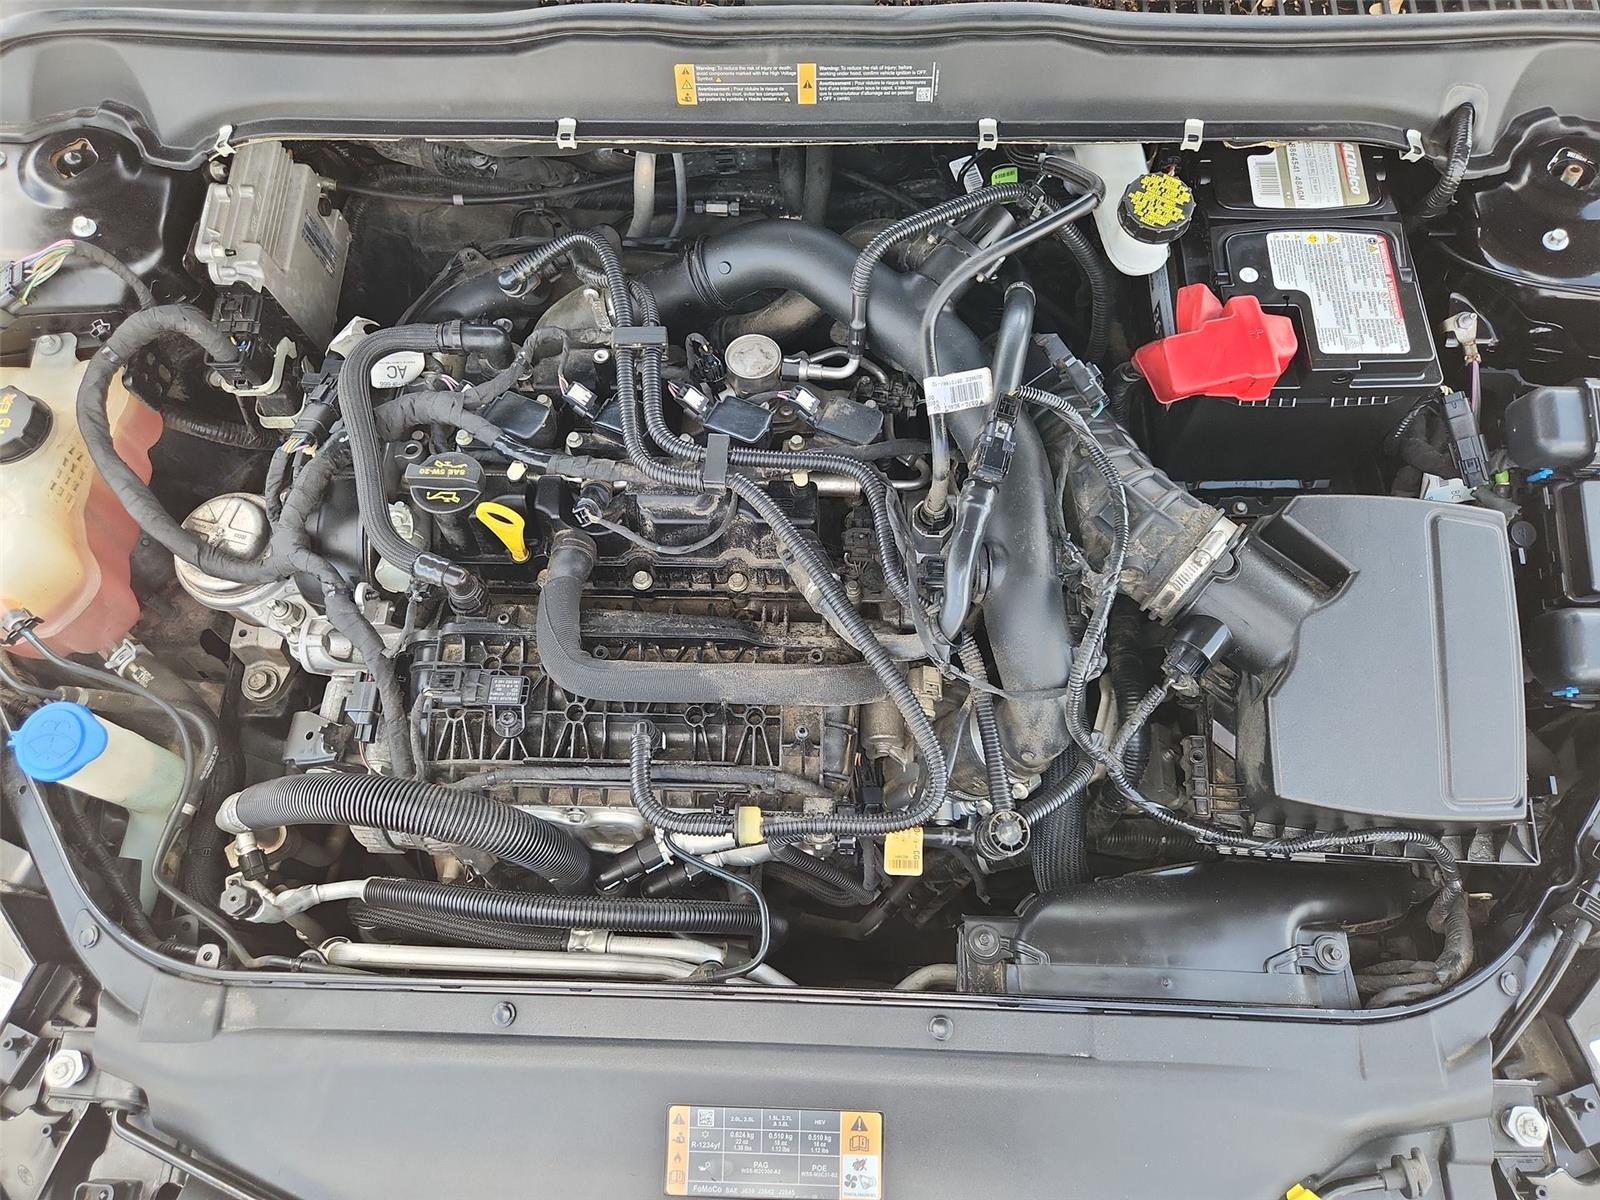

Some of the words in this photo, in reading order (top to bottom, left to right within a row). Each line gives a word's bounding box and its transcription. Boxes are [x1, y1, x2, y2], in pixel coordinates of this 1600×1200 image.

[386, 365, 406, 378] AC
[691, 1141, 721, 1150] R-1234yf
[693, 1185, 722, 1193] FoMoCo
